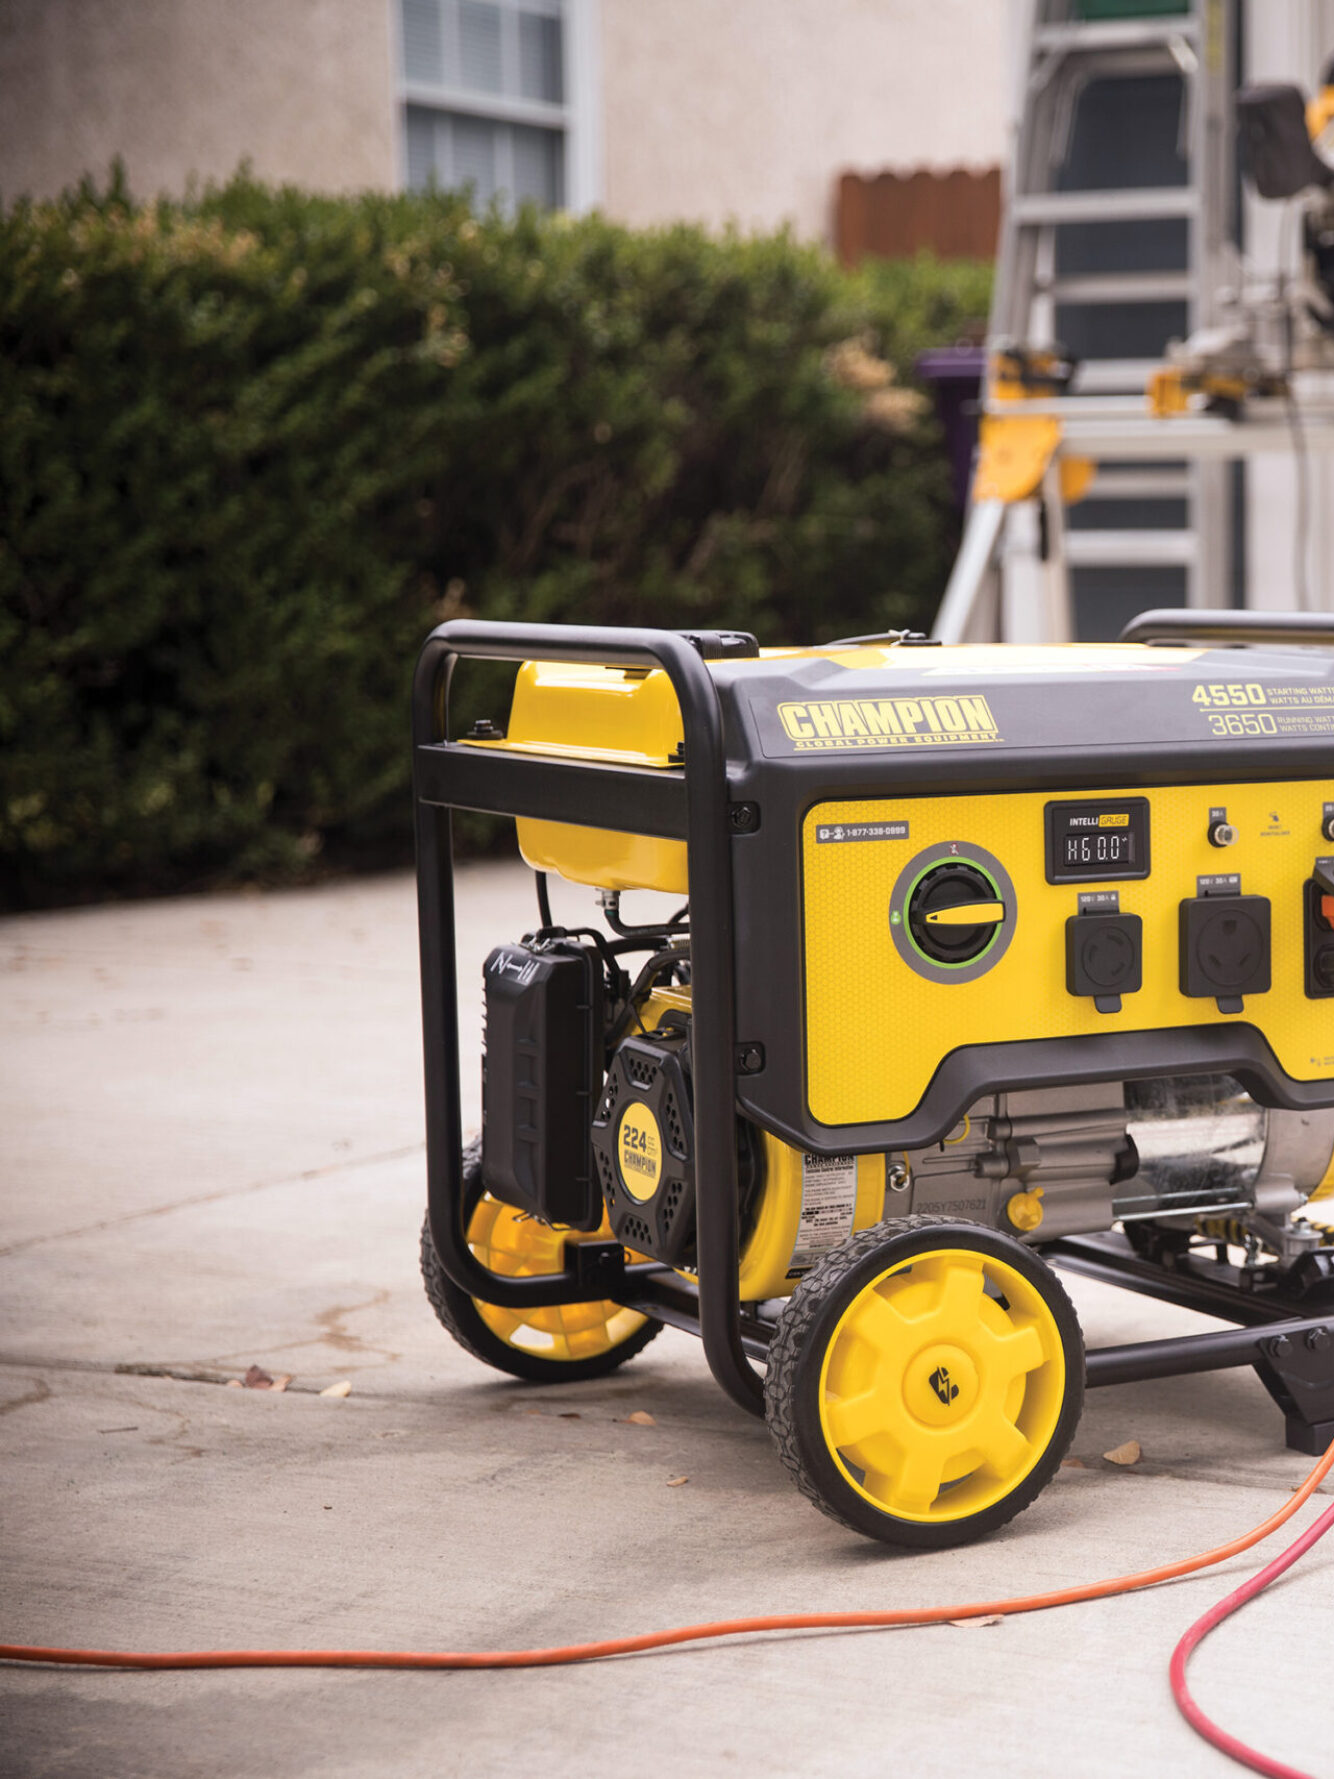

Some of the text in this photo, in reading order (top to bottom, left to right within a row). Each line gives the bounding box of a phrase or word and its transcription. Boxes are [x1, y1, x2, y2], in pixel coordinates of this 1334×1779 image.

[1192, 684, 1266, 706] 4550
[1266, 687, 1307, 696] STARTING
[1269, 696, 1299, 704] WATTS
[780, 697, 995, 739] CHAMPION
[1208, 713, 1278, 735] 3650
[1280, 724, 1307, 732] WATTS
[795, 733, 997, 748] GLOBAL POWER EQUIPMENT
[623, 1124, 647, 1153] 224
